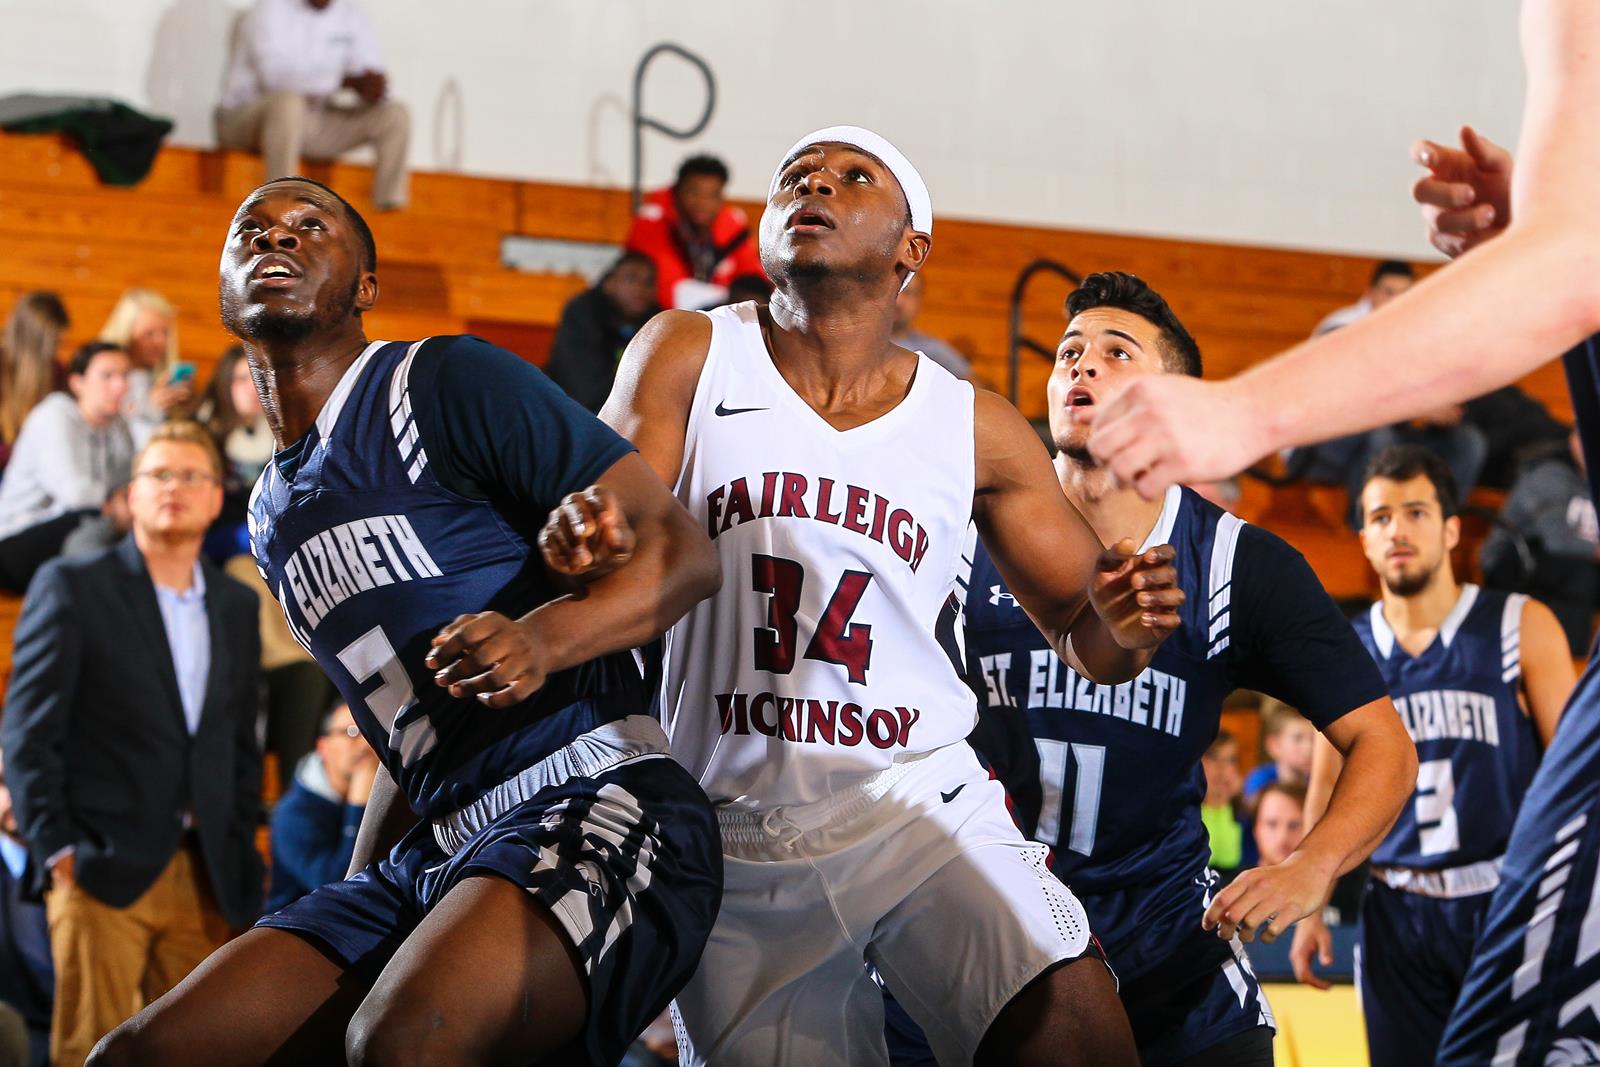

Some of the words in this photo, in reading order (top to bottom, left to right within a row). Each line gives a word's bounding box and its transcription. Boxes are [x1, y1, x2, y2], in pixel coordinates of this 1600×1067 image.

[284, 514, 444, 631] ELIZABETH
[707, 471, 929, 574] FAIRLEIGH
[751, 553, 874, 686] 34
[1033, 737, 1106, 857] 11
[1415, 758, 1460, 857] 3
